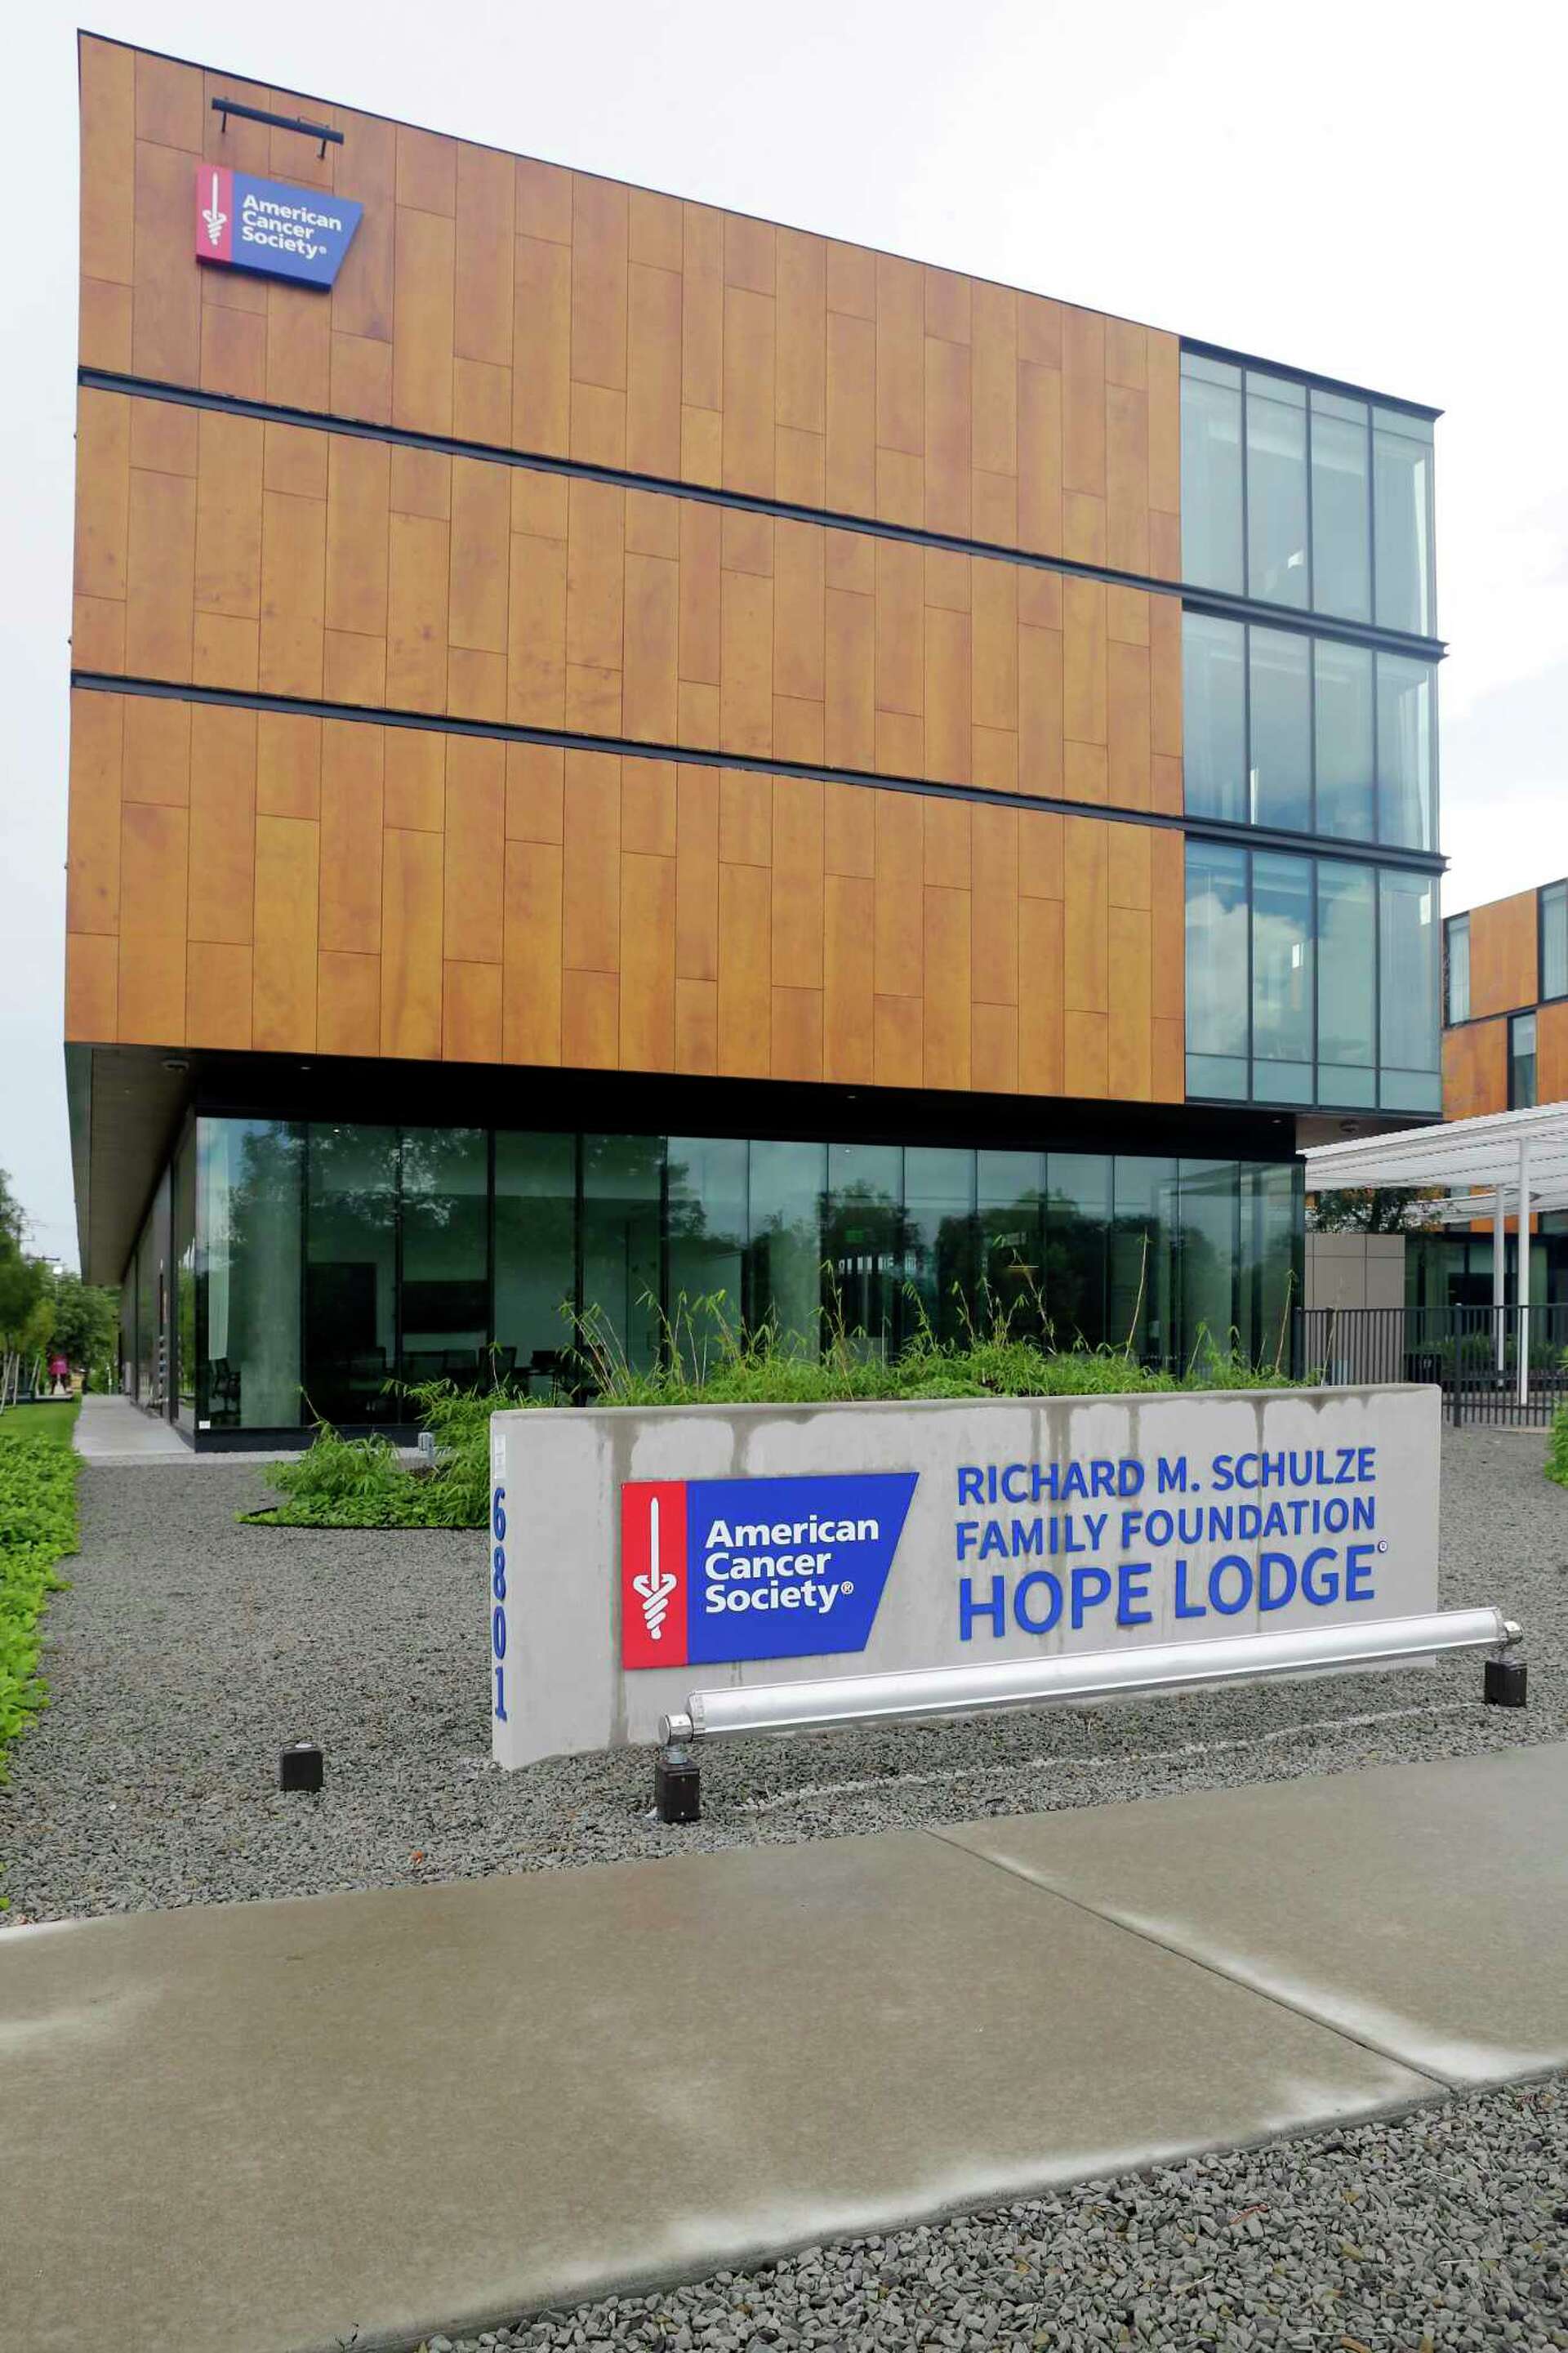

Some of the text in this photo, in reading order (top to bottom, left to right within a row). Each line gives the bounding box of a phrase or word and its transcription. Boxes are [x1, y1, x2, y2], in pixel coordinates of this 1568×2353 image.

[242, 210, 314, 239] Cancer
[243, 194, 342, 231] American
[957, 1446, 1378, 1507] RICHARD M. SCHULZE
[705, 1514, 879, 1549] American
[955, 1495, 1377, 1563] FAMILY FOUNDATION
[704, 1552, 831, 1581] Cancer
[492, 1488, 507, 1722] 6801
[958, 1562, 1154, 1643] HOPE
